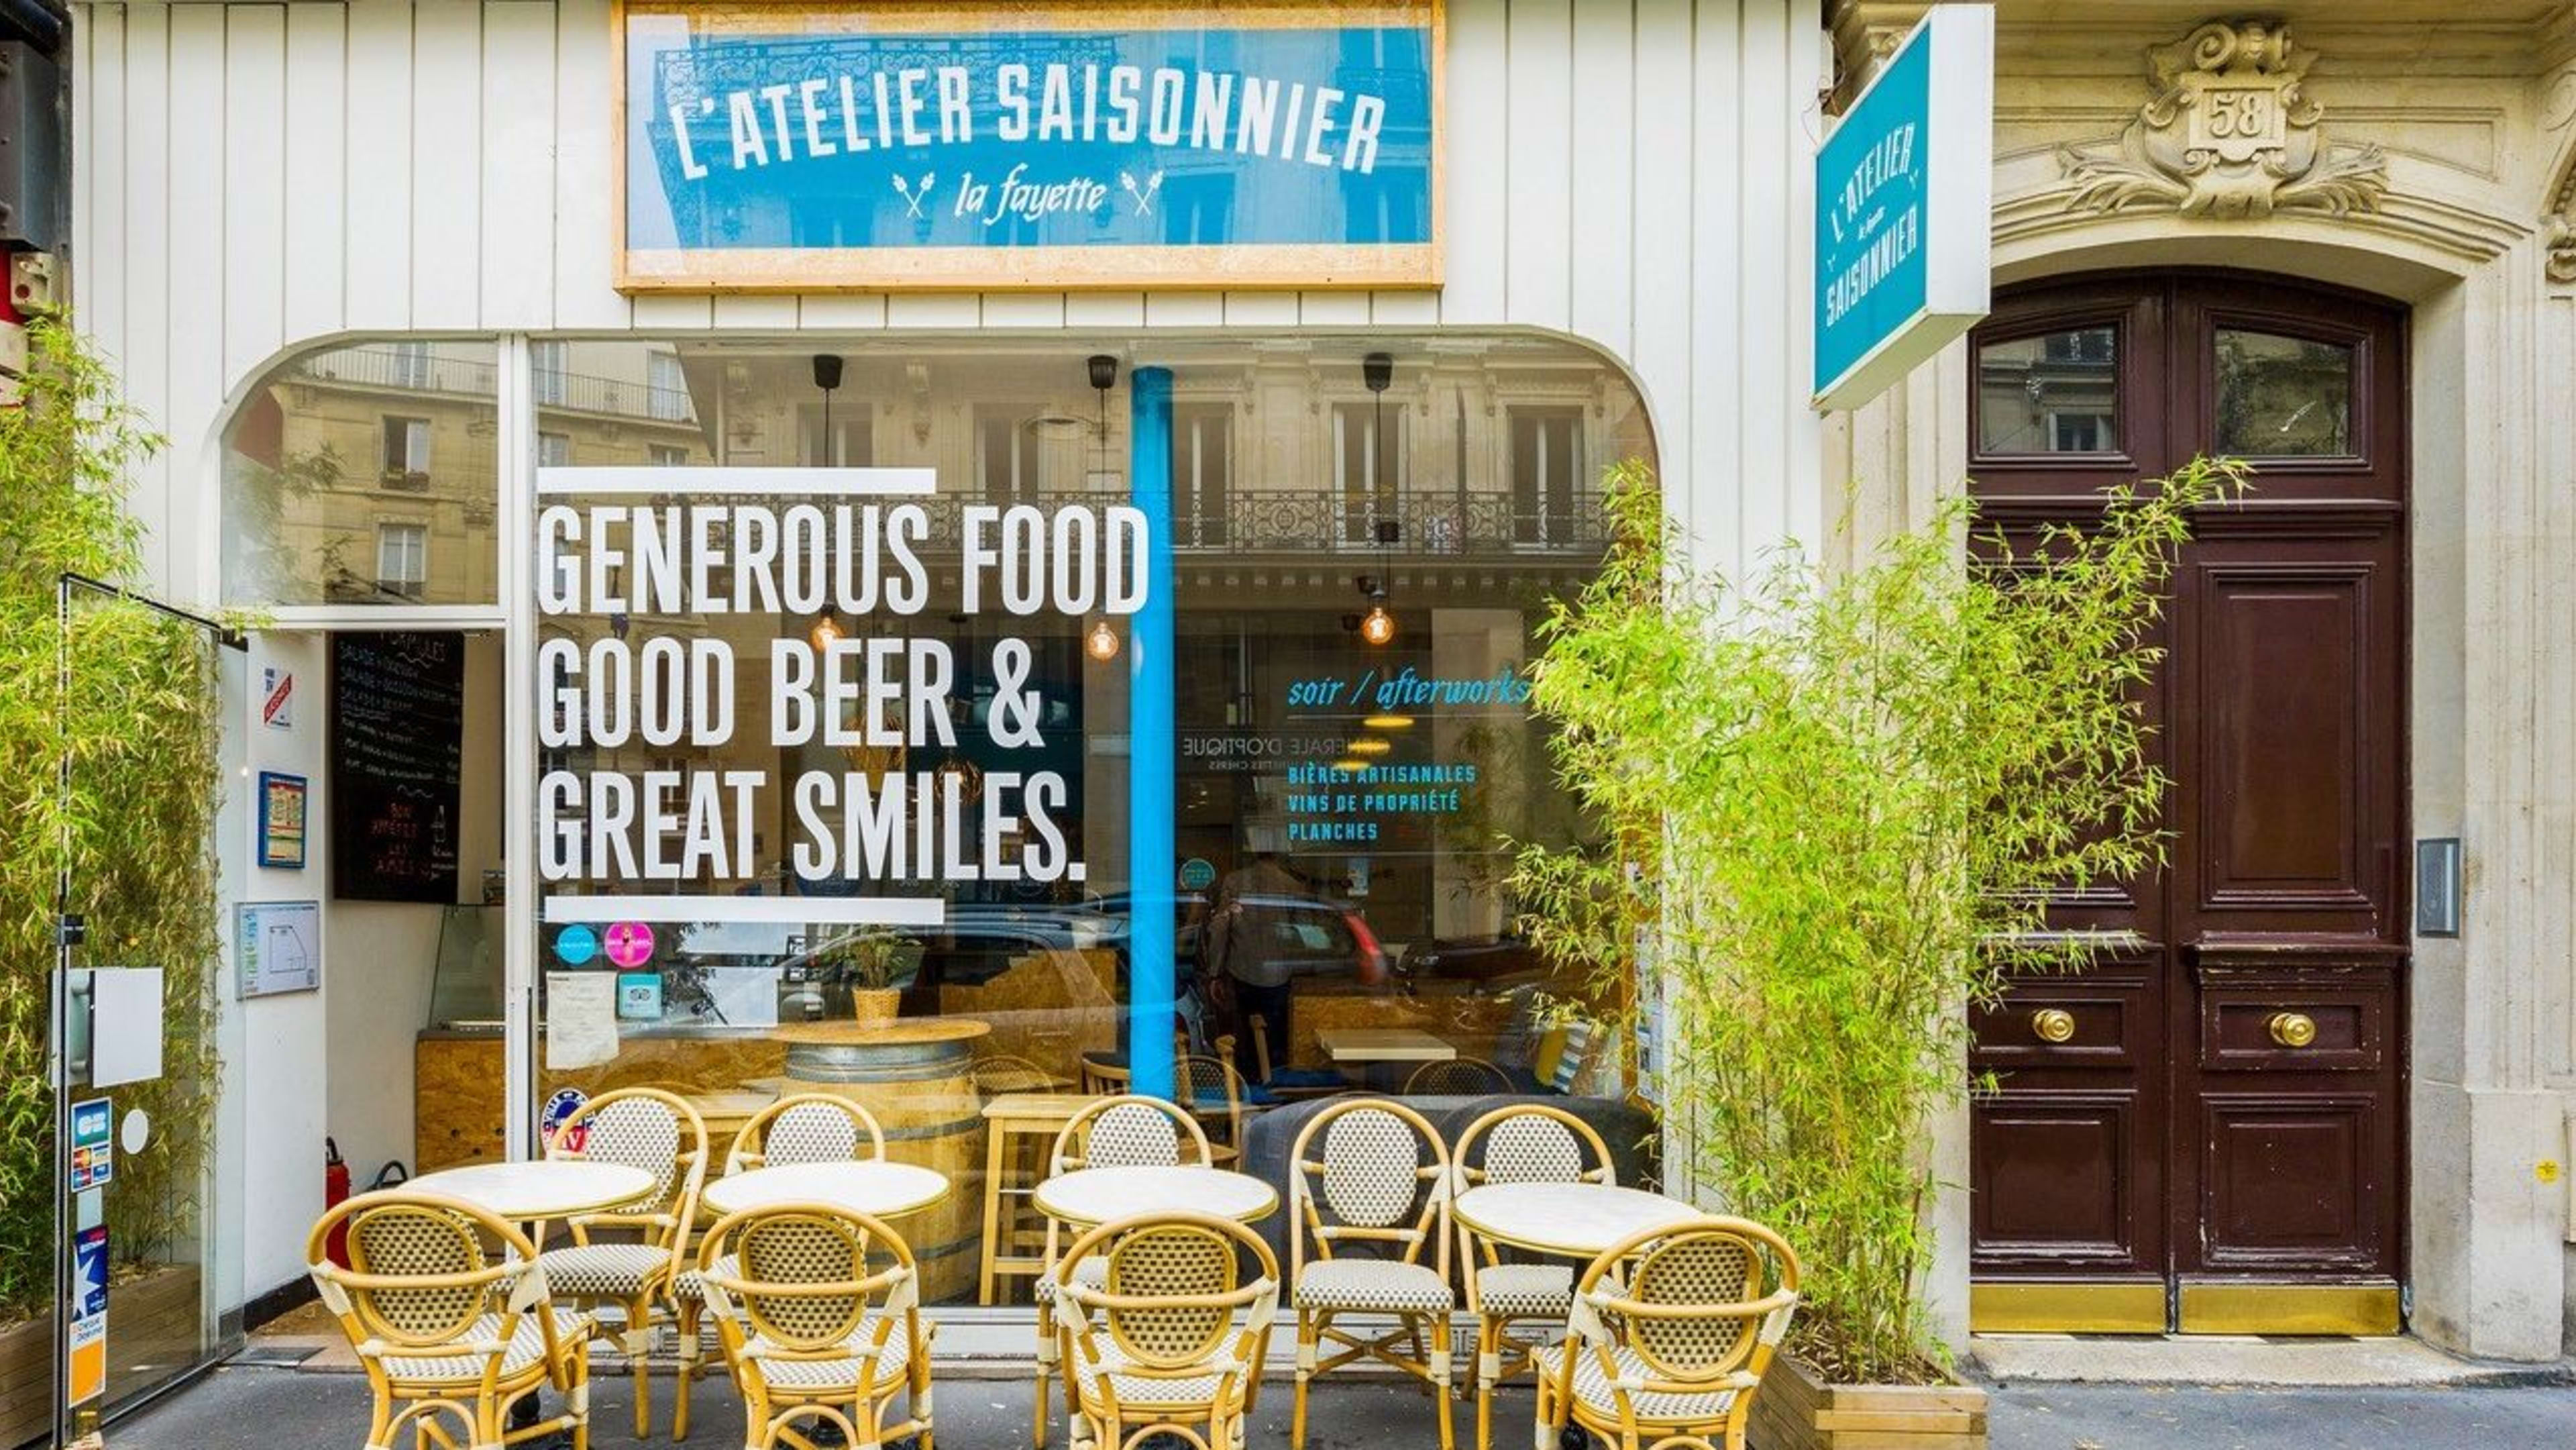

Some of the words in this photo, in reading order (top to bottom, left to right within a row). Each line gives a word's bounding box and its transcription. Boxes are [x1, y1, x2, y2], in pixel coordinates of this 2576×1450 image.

[669, 66, 973, 180] L'ATELIER
[998, 64, 1385, 174] SAISONNIER
[2209, 93, 2262, 138] 58
[954, 170, 989, 218] la
[984, 162, 1108, 225] fayette
[1831, 122, 1915, 244] L'ATELIER
[1826, 202, 1917, 327] SAISONNIER
[538, 505, 930, 615] GENEROUS
[962, 505, 1150, 615] FOOD
[538, 637, 735, 748] GOOD
[771, 637, 958, 748] BEER
[987, 637, 1046, 748] &
[1288, 676, 1344, 706] soir
[1376, 667, 1531, 710] afterworks
[1288, 762, 1350, 785] BIÈRES
[1357, 765, 1476, 784] ARTISANALES
[1288, 794, 1329, 813] VINS
[1336, 794, 1357, 812] DE
[1364, 789, 1458, 811] PROPRIÉTÉ
[538, 770, 766, 881] GREAT
[793, 770, 1087, 882] SMILES.
[1288, 823, 1377, 841] PLANCHES
